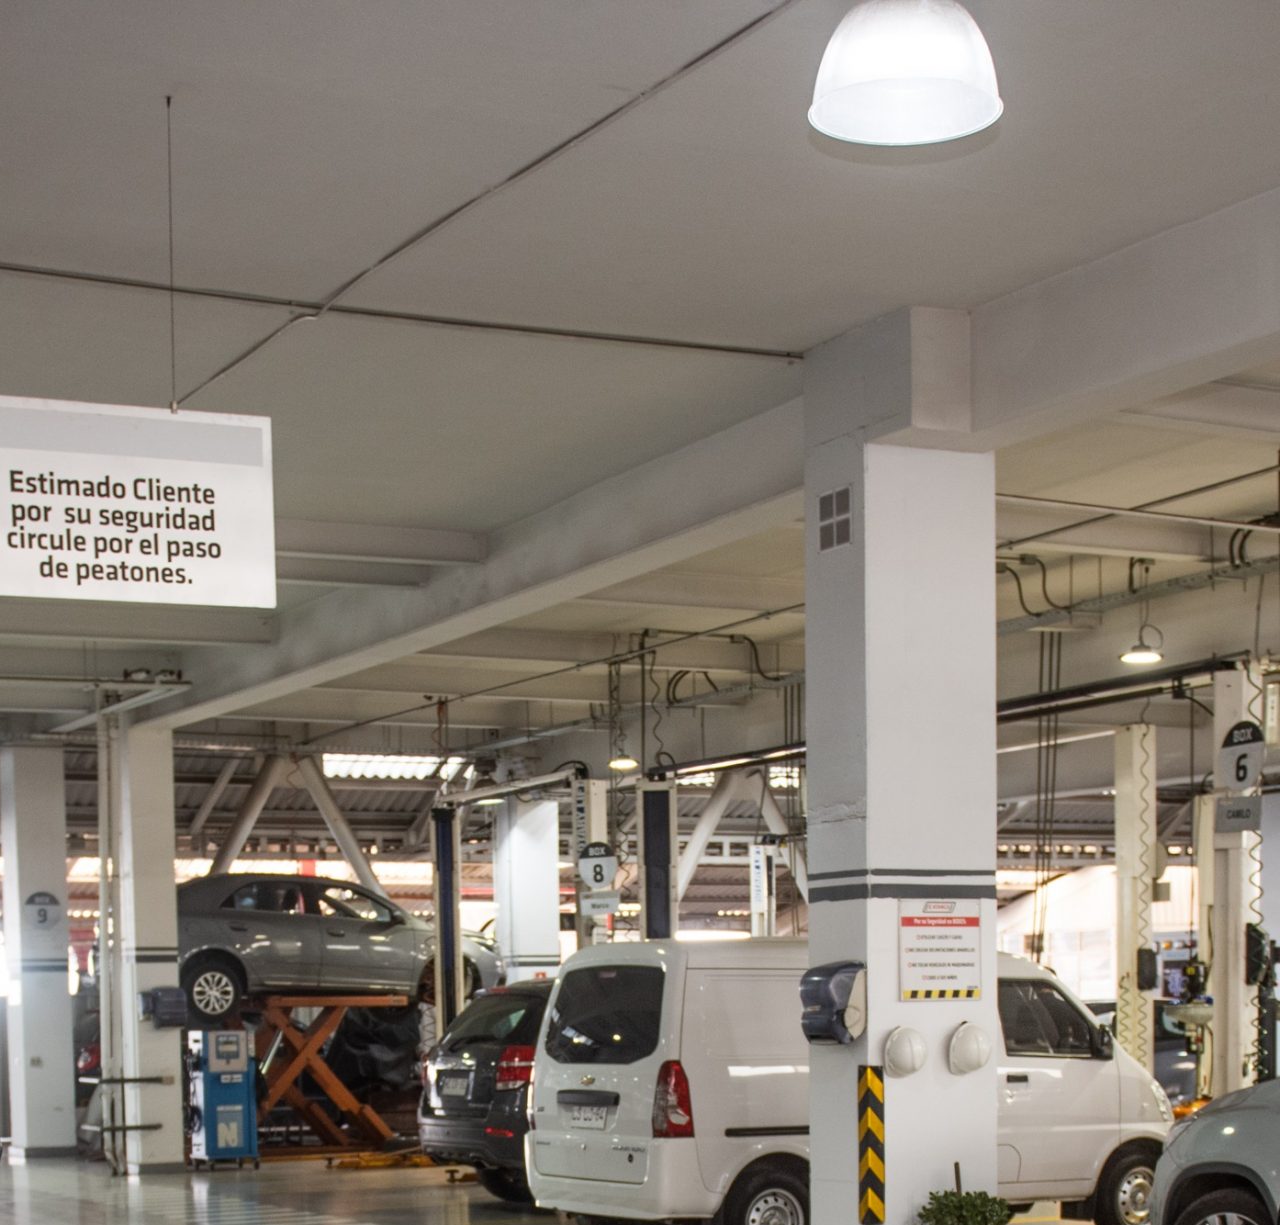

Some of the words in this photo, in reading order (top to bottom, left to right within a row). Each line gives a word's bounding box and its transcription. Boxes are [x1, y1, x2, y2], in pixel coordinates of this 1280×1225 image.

[10, 470, 125, 499] Estimado
[133, 478, 215, 504] Cliente
[11, 503, 51, 527] por
[64, 505, 91, 524] su
[99, 507, 215, 532] seguridad
[7, 529, 86, 552] circule
[94, 535, 133, 559] por
[140, 532, 159, 555] el
[167, 541, 221, 563] paso
[39, 555, 68, 579] de
[76, 561, 193, 586] peatones.
[1233, 728, 1253, 743] BOX
[1236, 754, 1248, 782] 6
[588, 846, 606, 857] BOX
[593, 864, 604, 883] 8
[38, 908, 47, 923] 9
